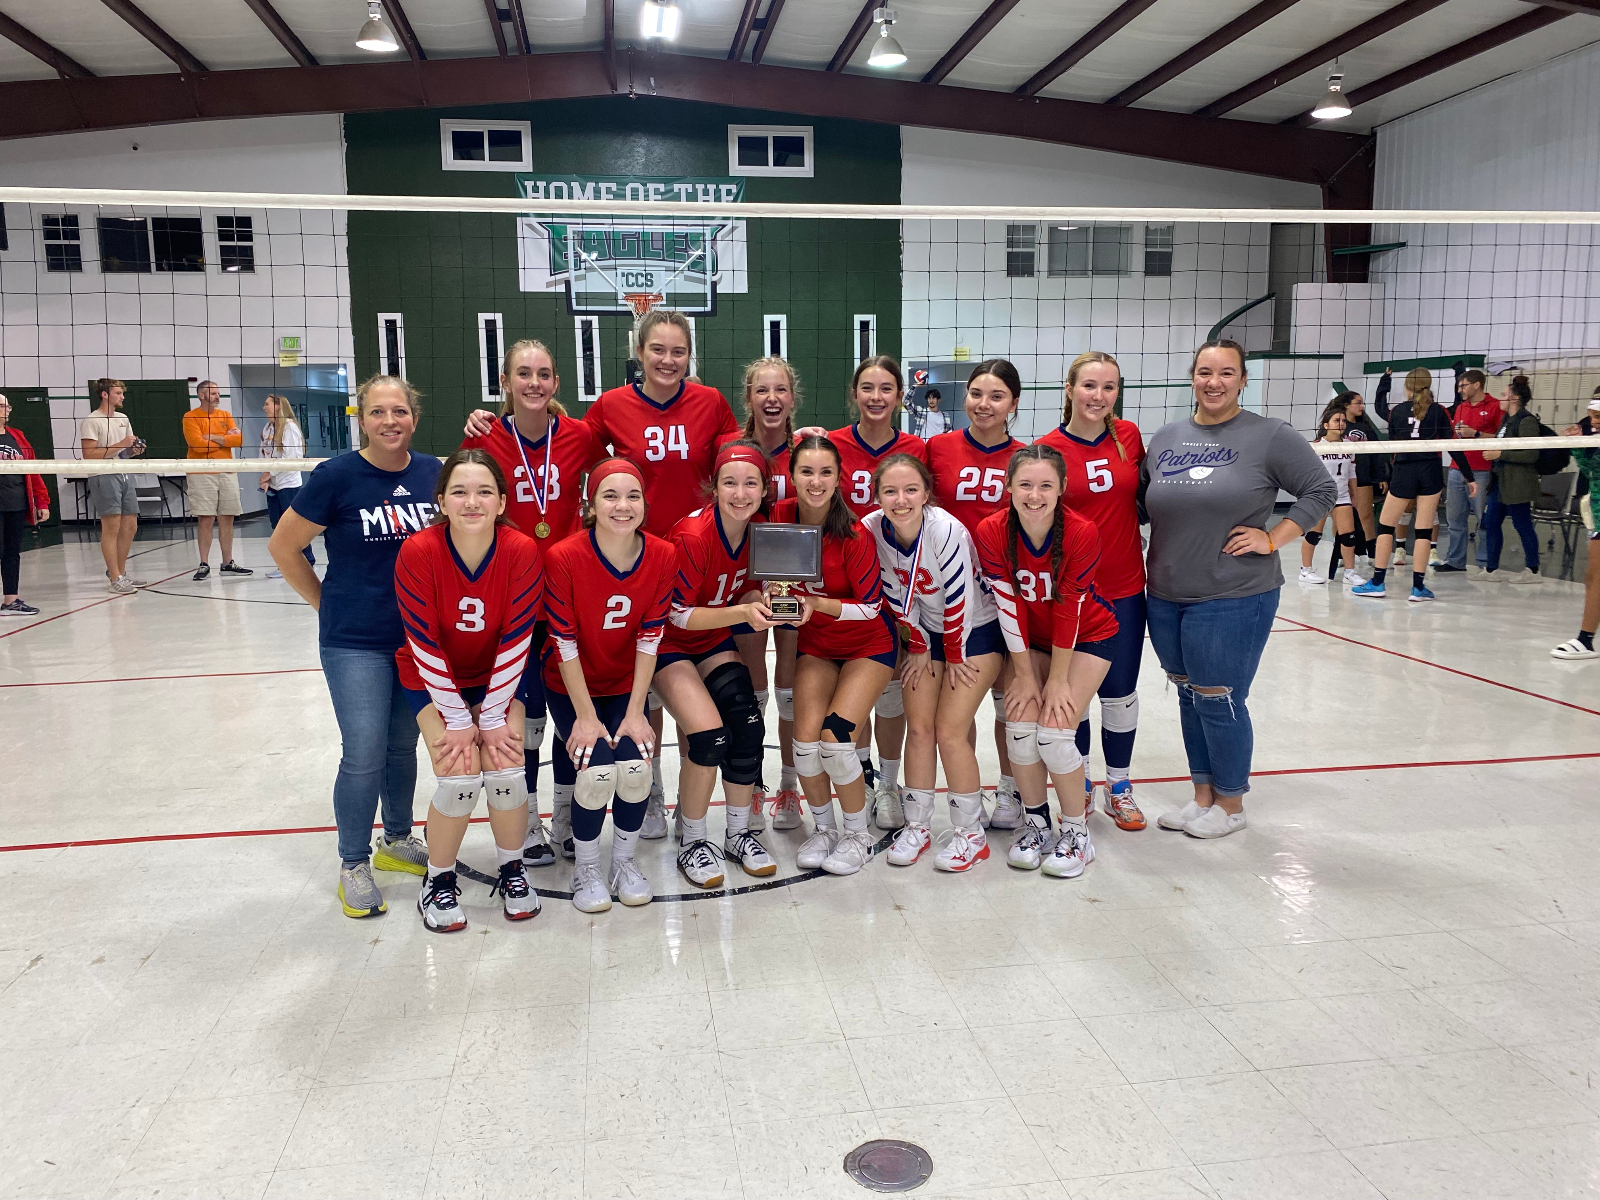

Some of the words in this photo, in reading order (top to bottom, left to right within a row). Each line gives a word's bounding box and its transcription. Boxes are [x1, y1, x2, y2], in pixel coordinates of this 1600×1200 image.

[524, 181, 617, 200] HOME
[625, 183, 665, 202] OF
[674, 184, 736, 203] THE
[538, 221, 727, 276] EAGLES
[644, 424, 690, 462] 34
[1156, 447, 1239, 470] Patriots
[513, 463, 561, 503] 23
[955, 466, 1006, 503] 25
[1085, 458, 1114, 494] 5
[1336, 462, 1343, 476] 1
[359, 502, 440, 536] MINE
[707, 567, 749, 606] 15
[1015, 569, 1054, 604] 31
[455, 595, 486, 633] 3
[602, 594, 632, 630] 2
